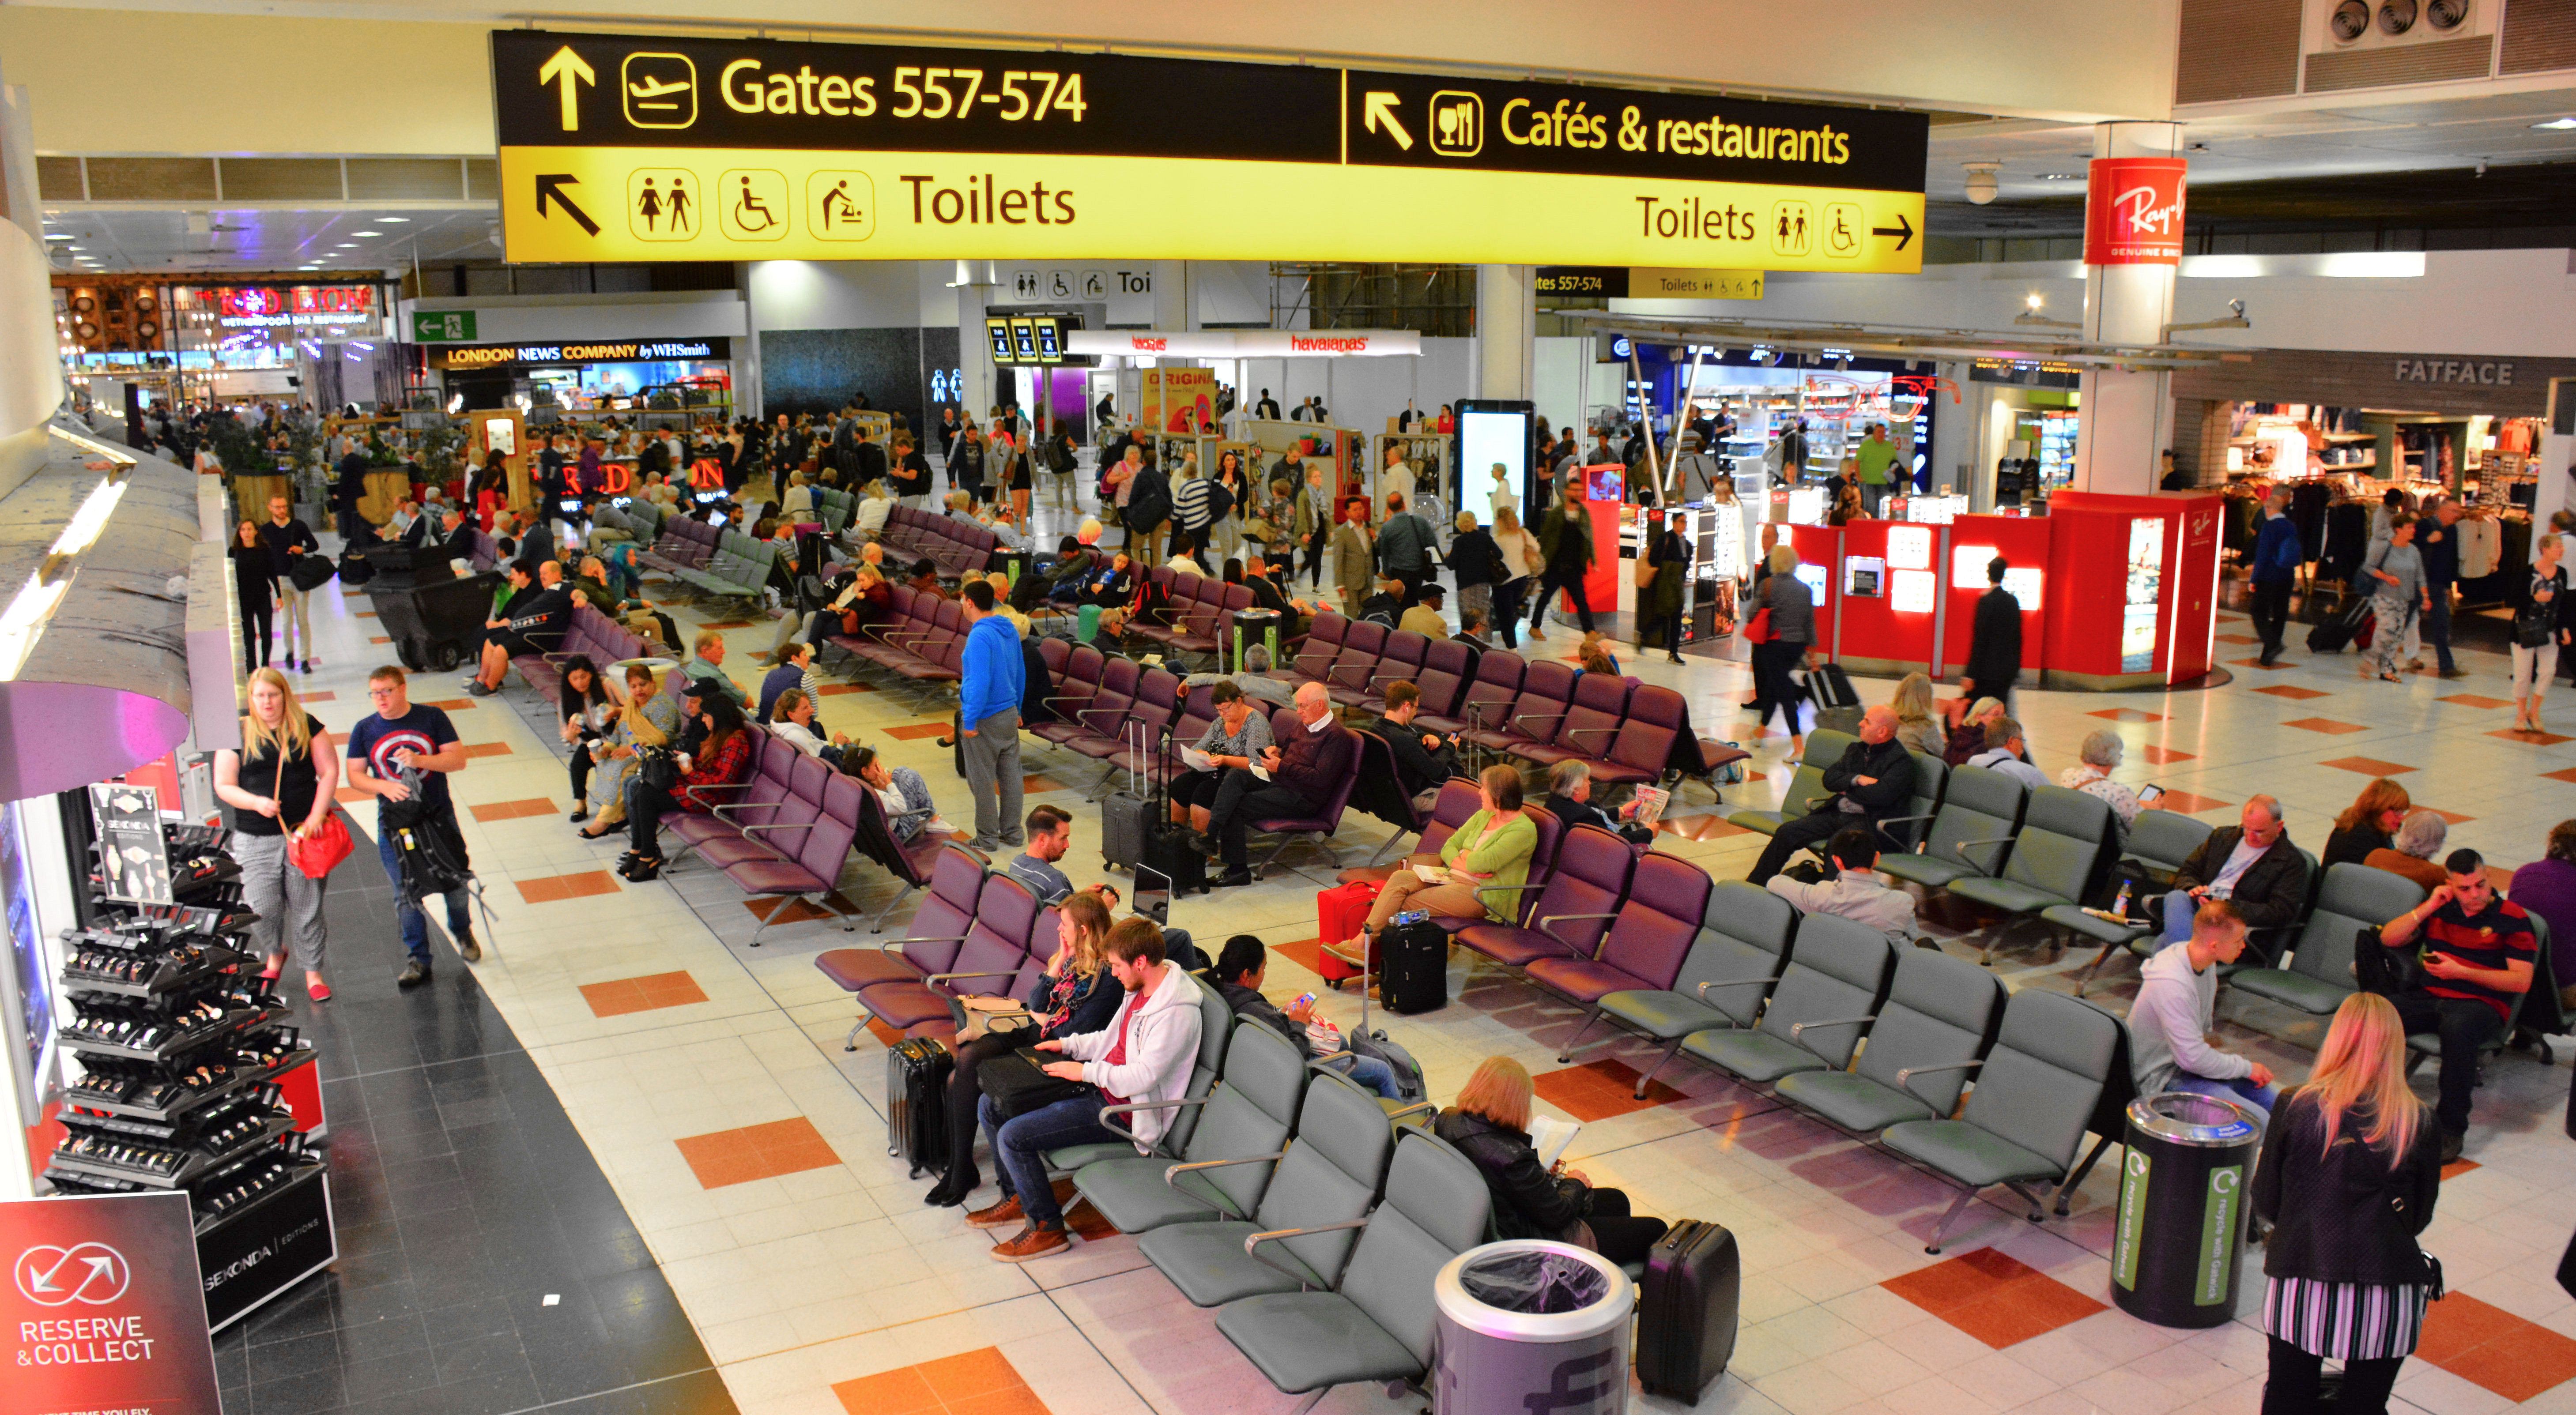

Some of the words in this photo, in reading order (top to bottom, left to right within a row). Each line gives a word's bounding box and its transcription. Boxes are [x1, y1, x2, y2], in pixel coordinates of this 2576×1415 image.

[721, 59, 877, 117] Gates
[893, 67, 1087, 122] 557-574
[1501, 98, 1607, 149] Cafés
[1618, 105, 1647, 151] &
[1658, 116, 1849, 164] restaurants
[900, 173, 1075, 224] Toilets
[1636, 196, 1754, 241] Toilets
[2111, 248, 2160, 257] GENUINE
[1558, 276, 1602, 290] 557-574
[1660, 278, 1697, 291] Toilets
[220, 288, 282, 317] RED
[290, 288, 367, 313] LION
[448, 348, 515, 363] LONDON
[518, 347, 561, 361] NEWS
[562, 344, 637, 359] COMPANY
[640, 345, 652, 359] by
[652, 343, 710, 357] WHSmith
[1291, 335, 1366, 352] havaianas
[2395, 360, 2514, 386] FATFACE
[2215, 1198, 2228, 1235] recycle
[204, 1245, 272, 1292] SEKONDA
[281, 1218, 319, 1245] EDITIONS
[20, 1316, 144, 1343] RESERVE
